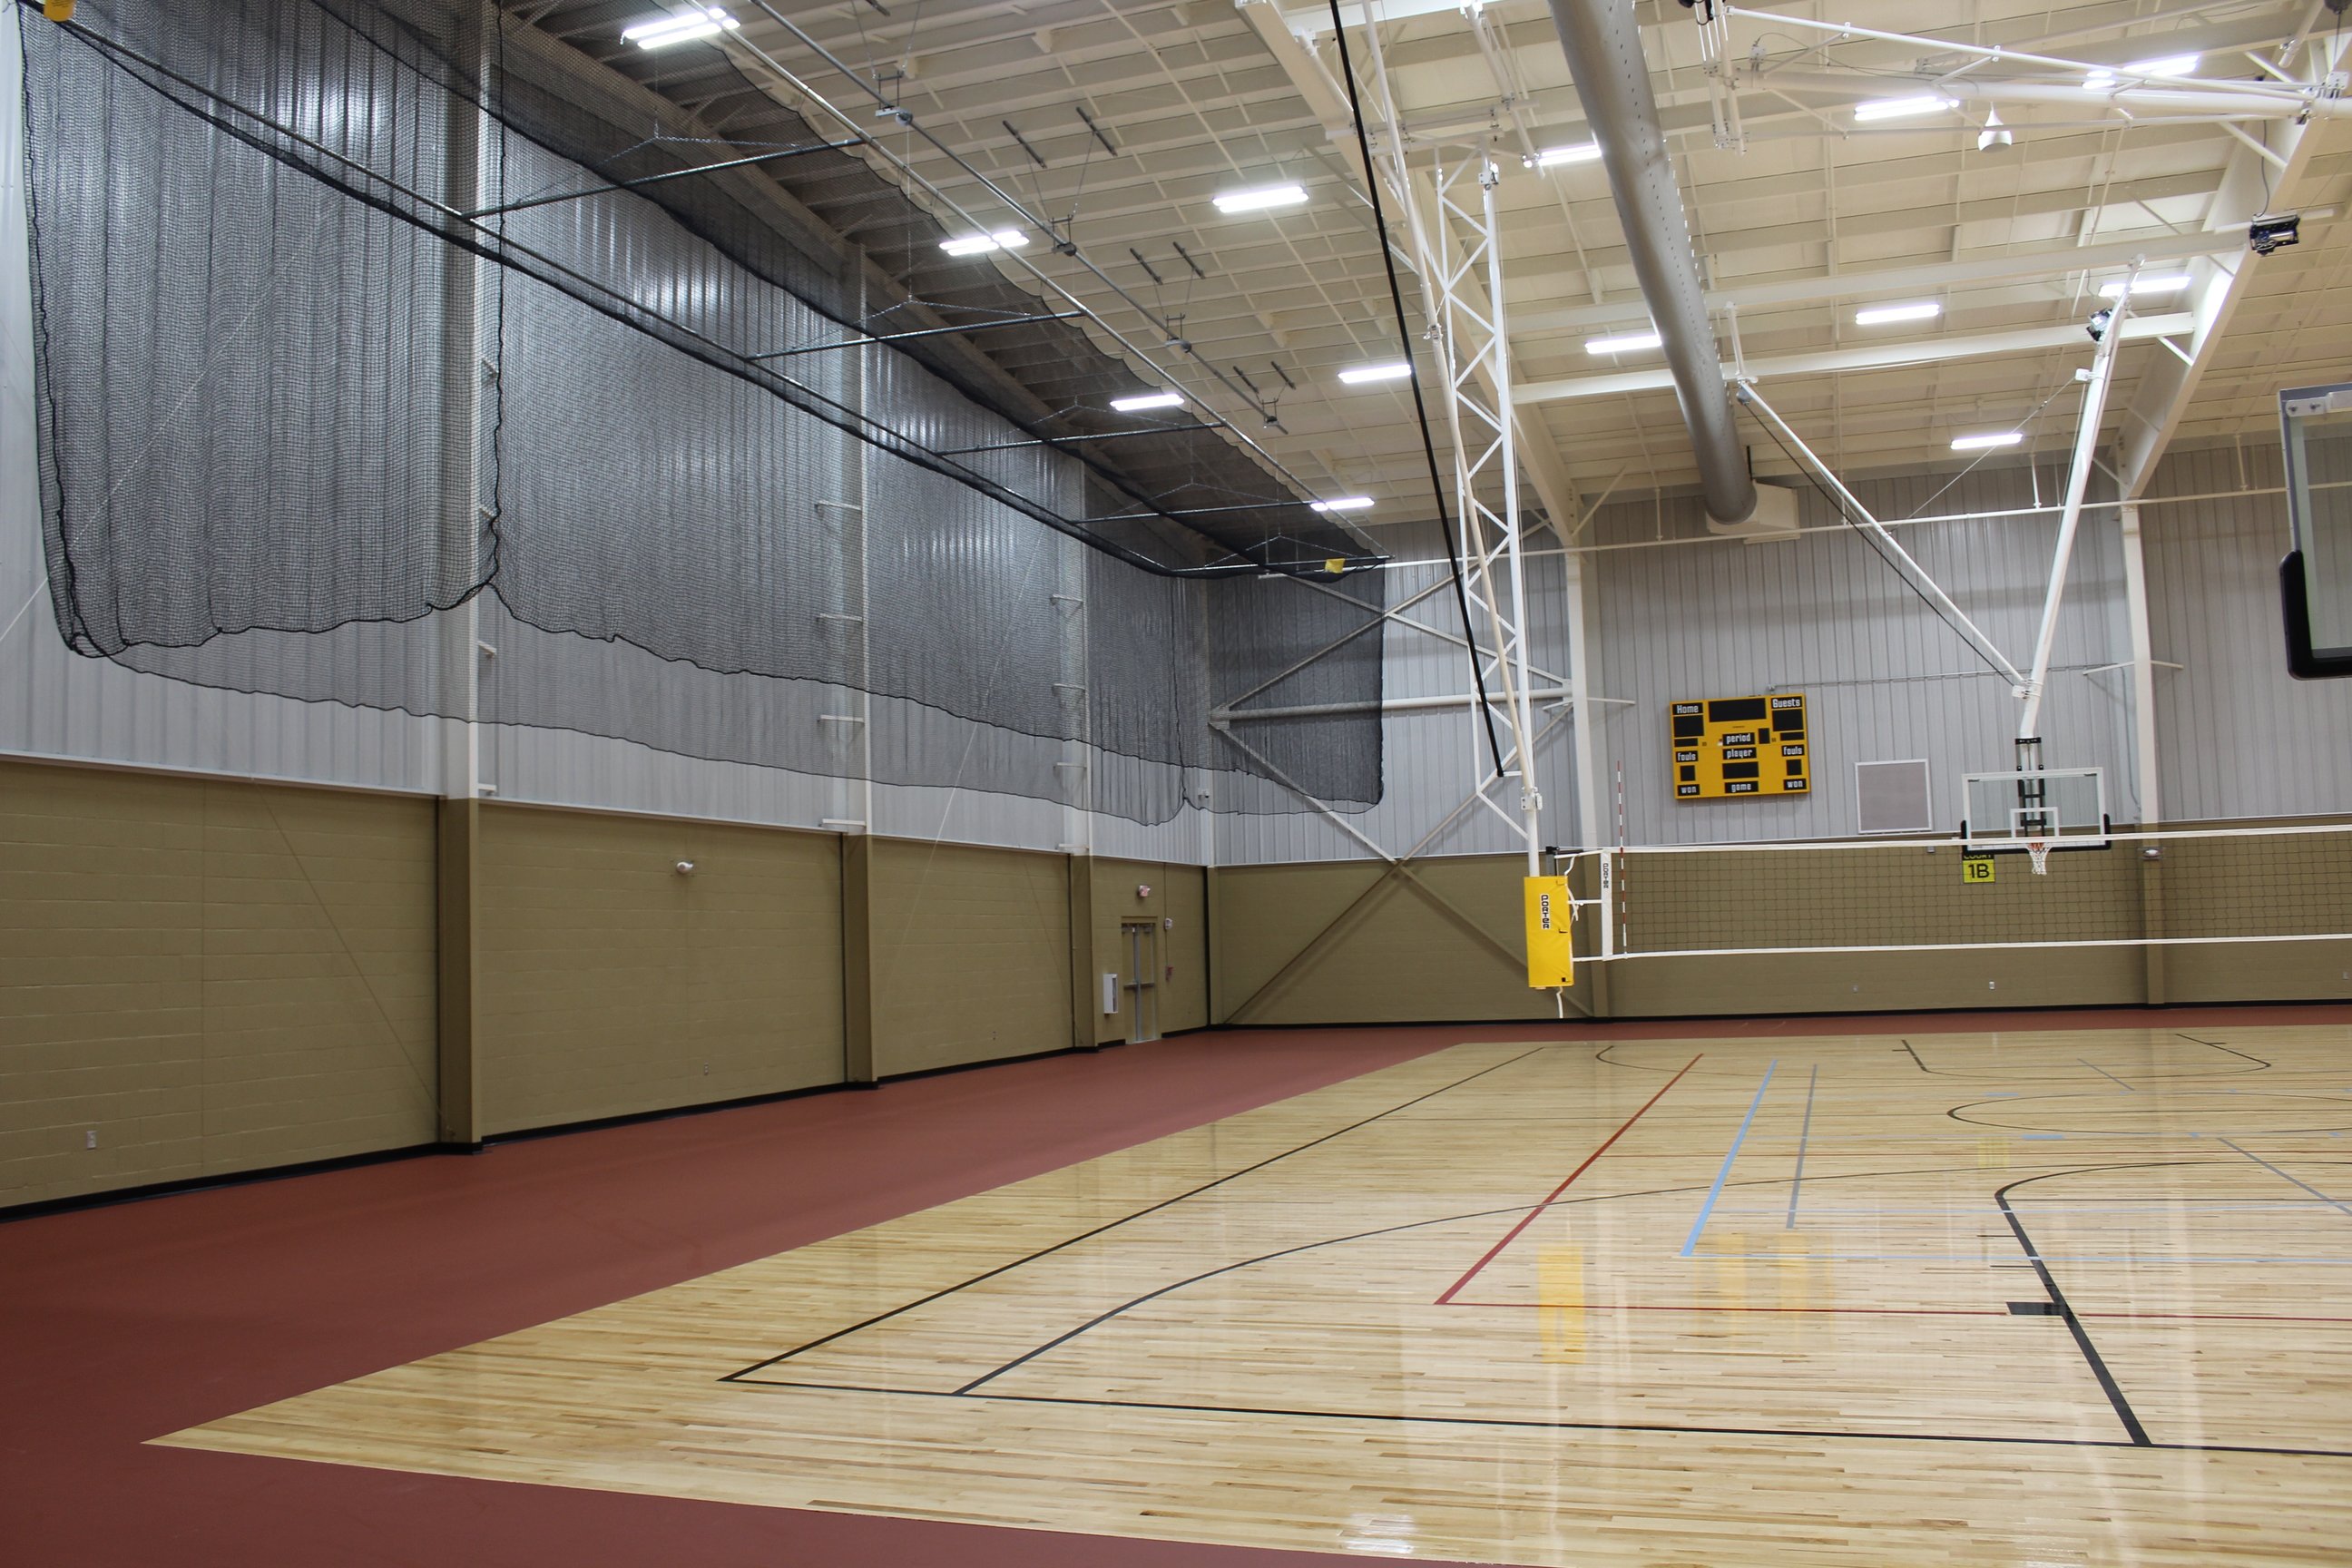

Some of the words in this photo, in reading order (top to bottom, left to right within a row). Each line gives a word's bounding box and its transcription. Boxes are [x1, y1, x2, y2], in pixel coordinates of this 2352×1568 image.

[1773, 698, 1800, 708] Guests
[1677, 705, 1699, 714] Home
[1726, 733, 1751, 745] period
[1726, 749, 1753, 759] player
[1784, 746, 1803, 755] fouls
[1677, 752, 1696, 761] fouls
[1731, 783, 1752, 793] game
[1968, 864, 1990, 879] 1B
